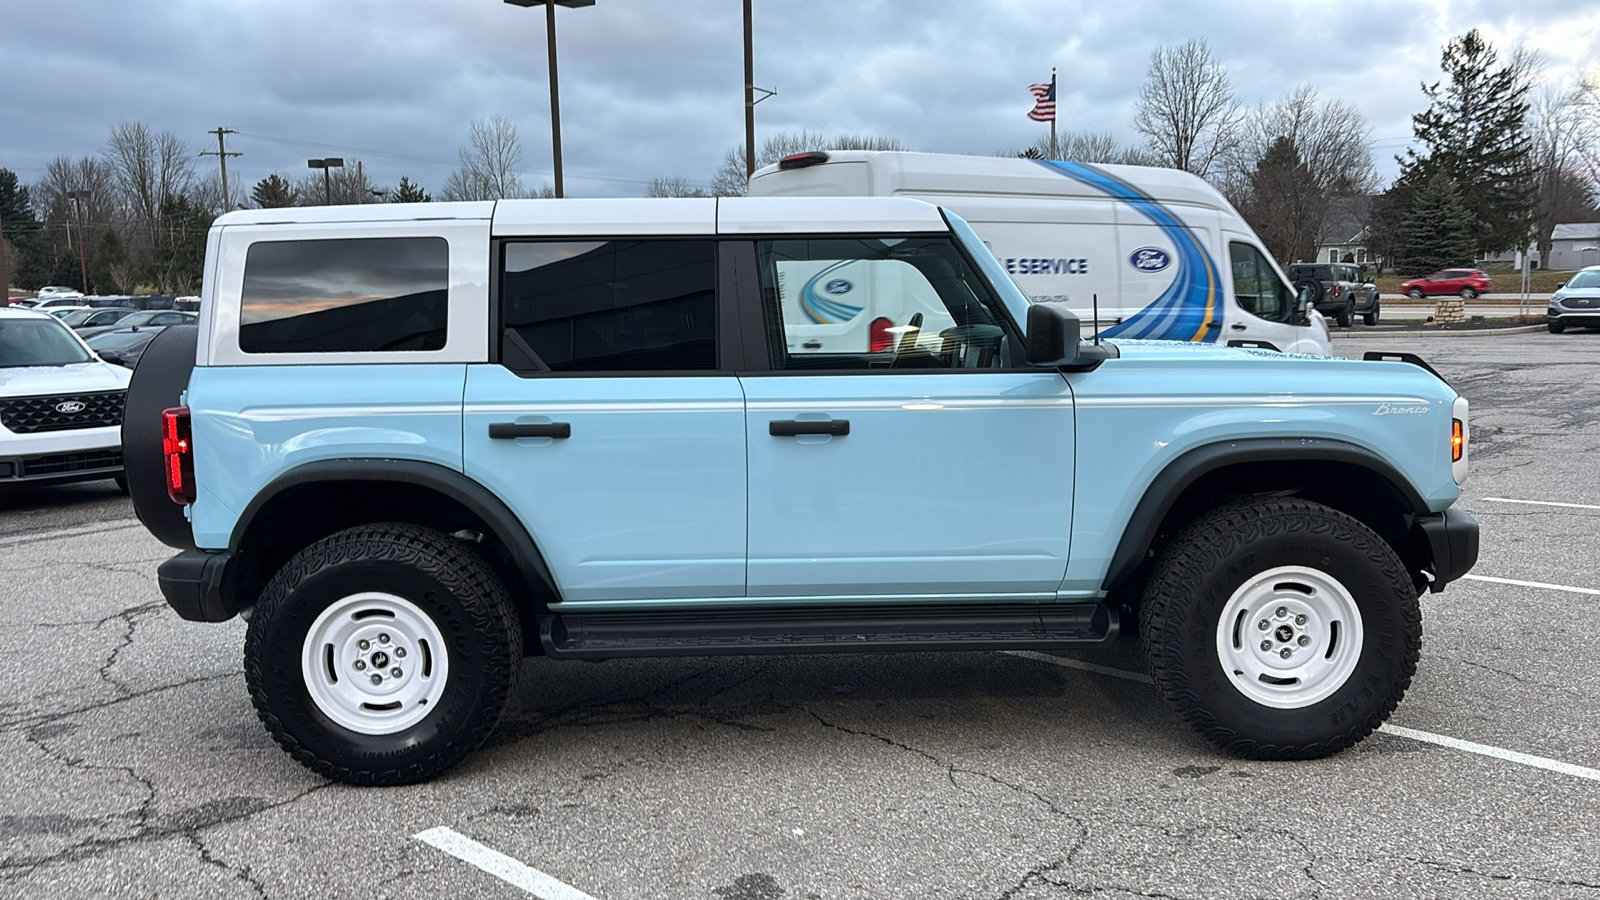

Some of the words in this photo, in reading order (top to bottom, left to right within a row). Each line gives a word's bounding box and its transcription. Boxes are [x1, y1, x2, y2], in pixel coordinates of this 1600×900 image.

[1019, 258, 1088, 274] SERVICE
[1135, 250, 1166, 269] Ford
[61, 401, 80, 412] Ford
[1371, 401, 1430, 416] Bronco
